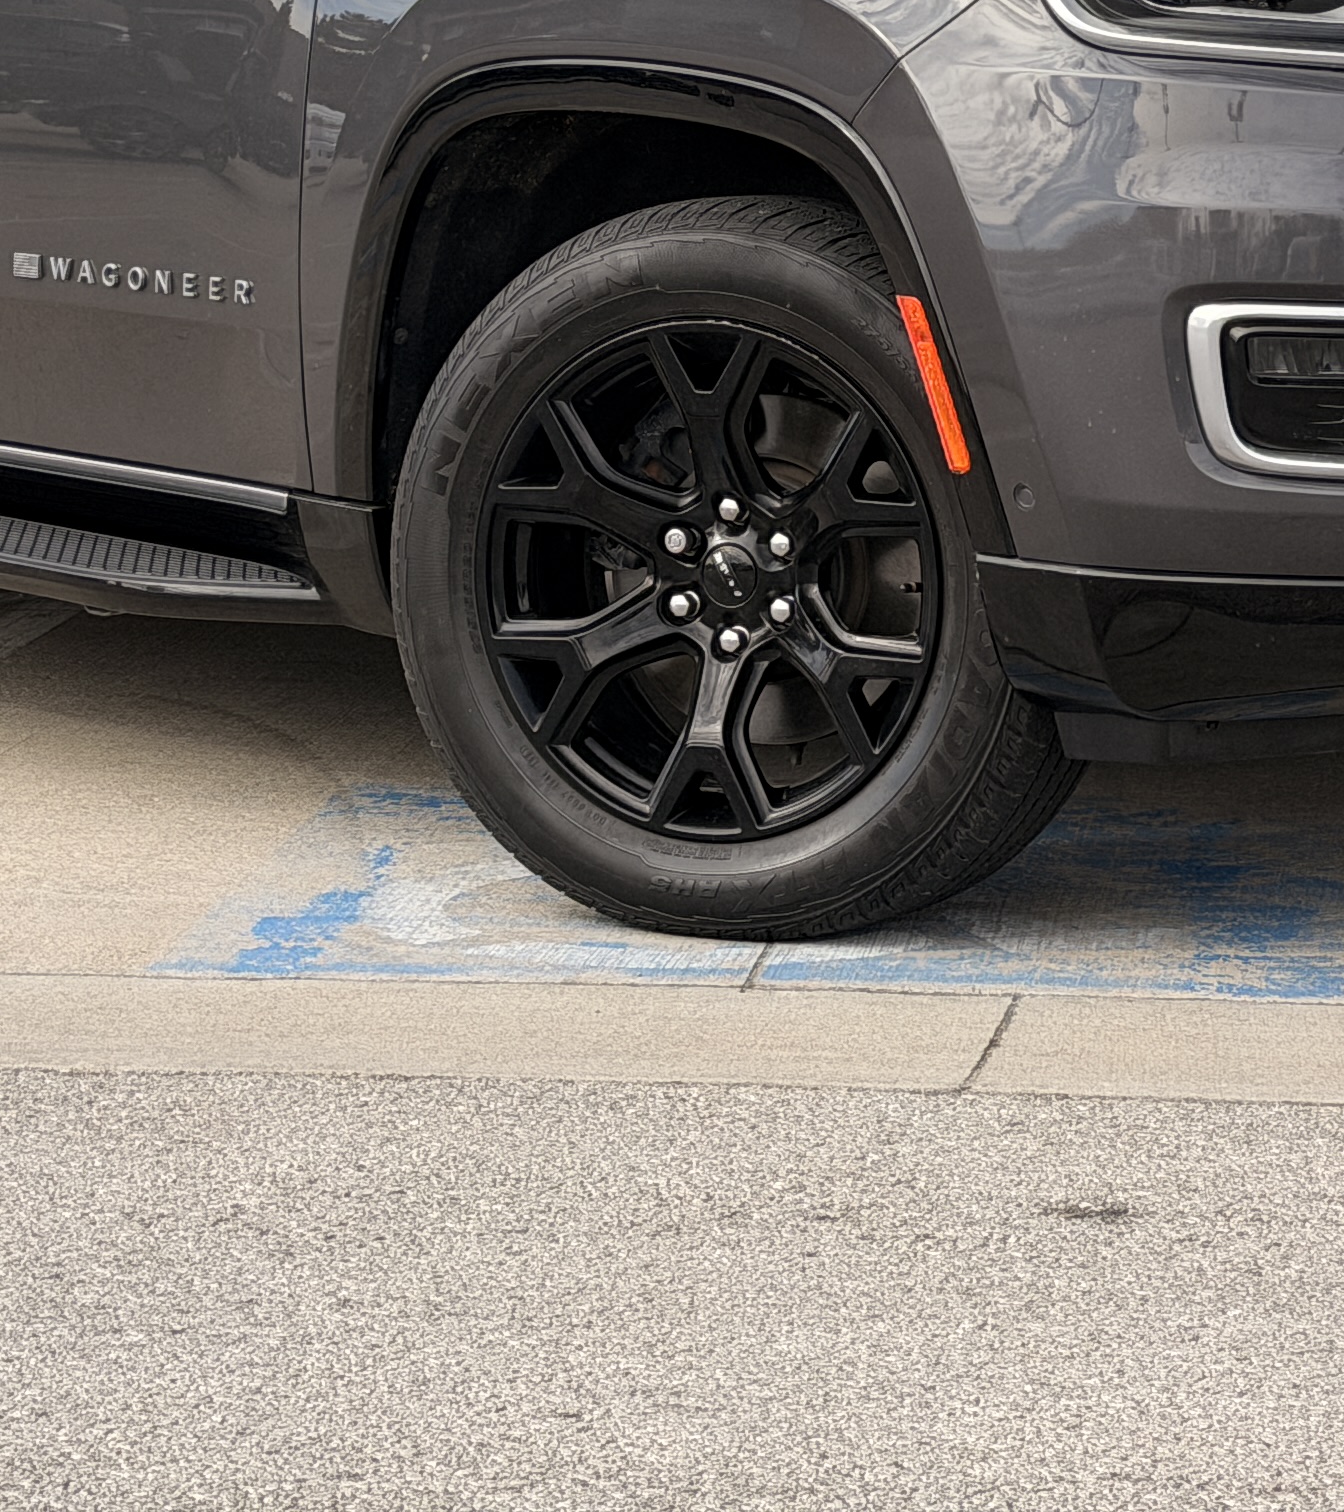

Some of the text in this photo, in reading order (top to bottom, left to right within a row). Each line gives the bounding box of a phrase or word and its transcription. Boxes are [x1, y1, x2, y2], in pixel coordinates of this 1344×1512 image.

[49, 256, 256, 305] WAGONEER
[419, 254, 644, 497] NEXEN
[870, 608, 999, 846] OADIAN
